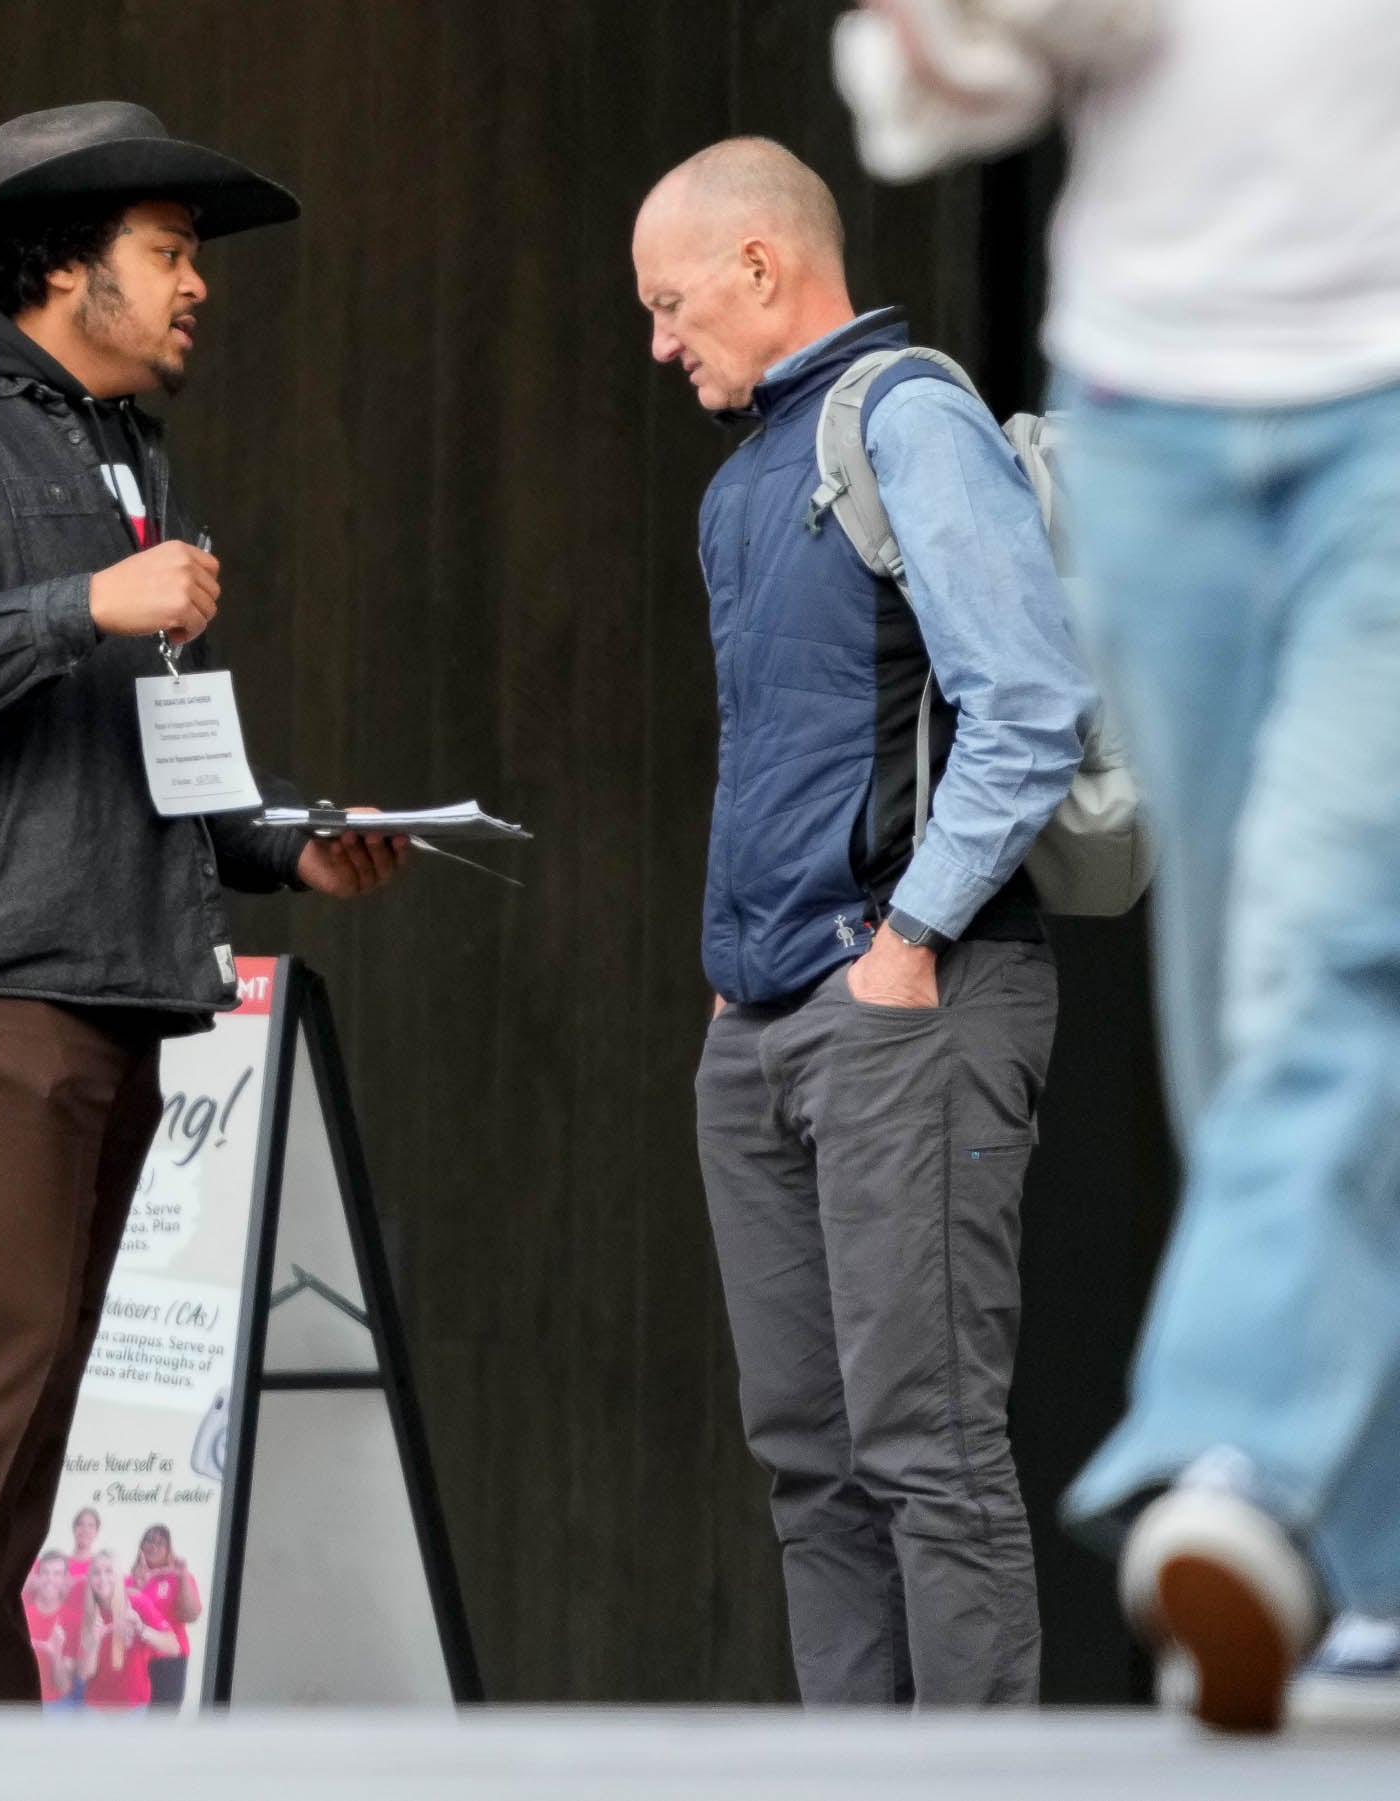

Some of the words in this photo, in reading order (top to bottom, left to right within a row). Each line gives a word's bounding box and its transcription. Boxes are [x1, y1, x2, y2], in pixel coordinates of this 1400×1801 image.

[163, 1066, 254, 1167] ng!
[145, 1201, 181, 1216] Serve
[152, 1218, 180, 1233] Plan
[164, 1299, 220, 1331] (CAs)
[168, 1335, 206, 1353] Serve
[207, 1344, 224, 1356] on
[105, 1346, 195, 1371] walkthroughs
[198, 1355, 214, 1371] of
[118, 1364, 150, 1381] after
[104, 1450, 160, 1473] Yourself
[159, 1457, 175, 1473] as
[105, 1480, 162, 1505] Student
